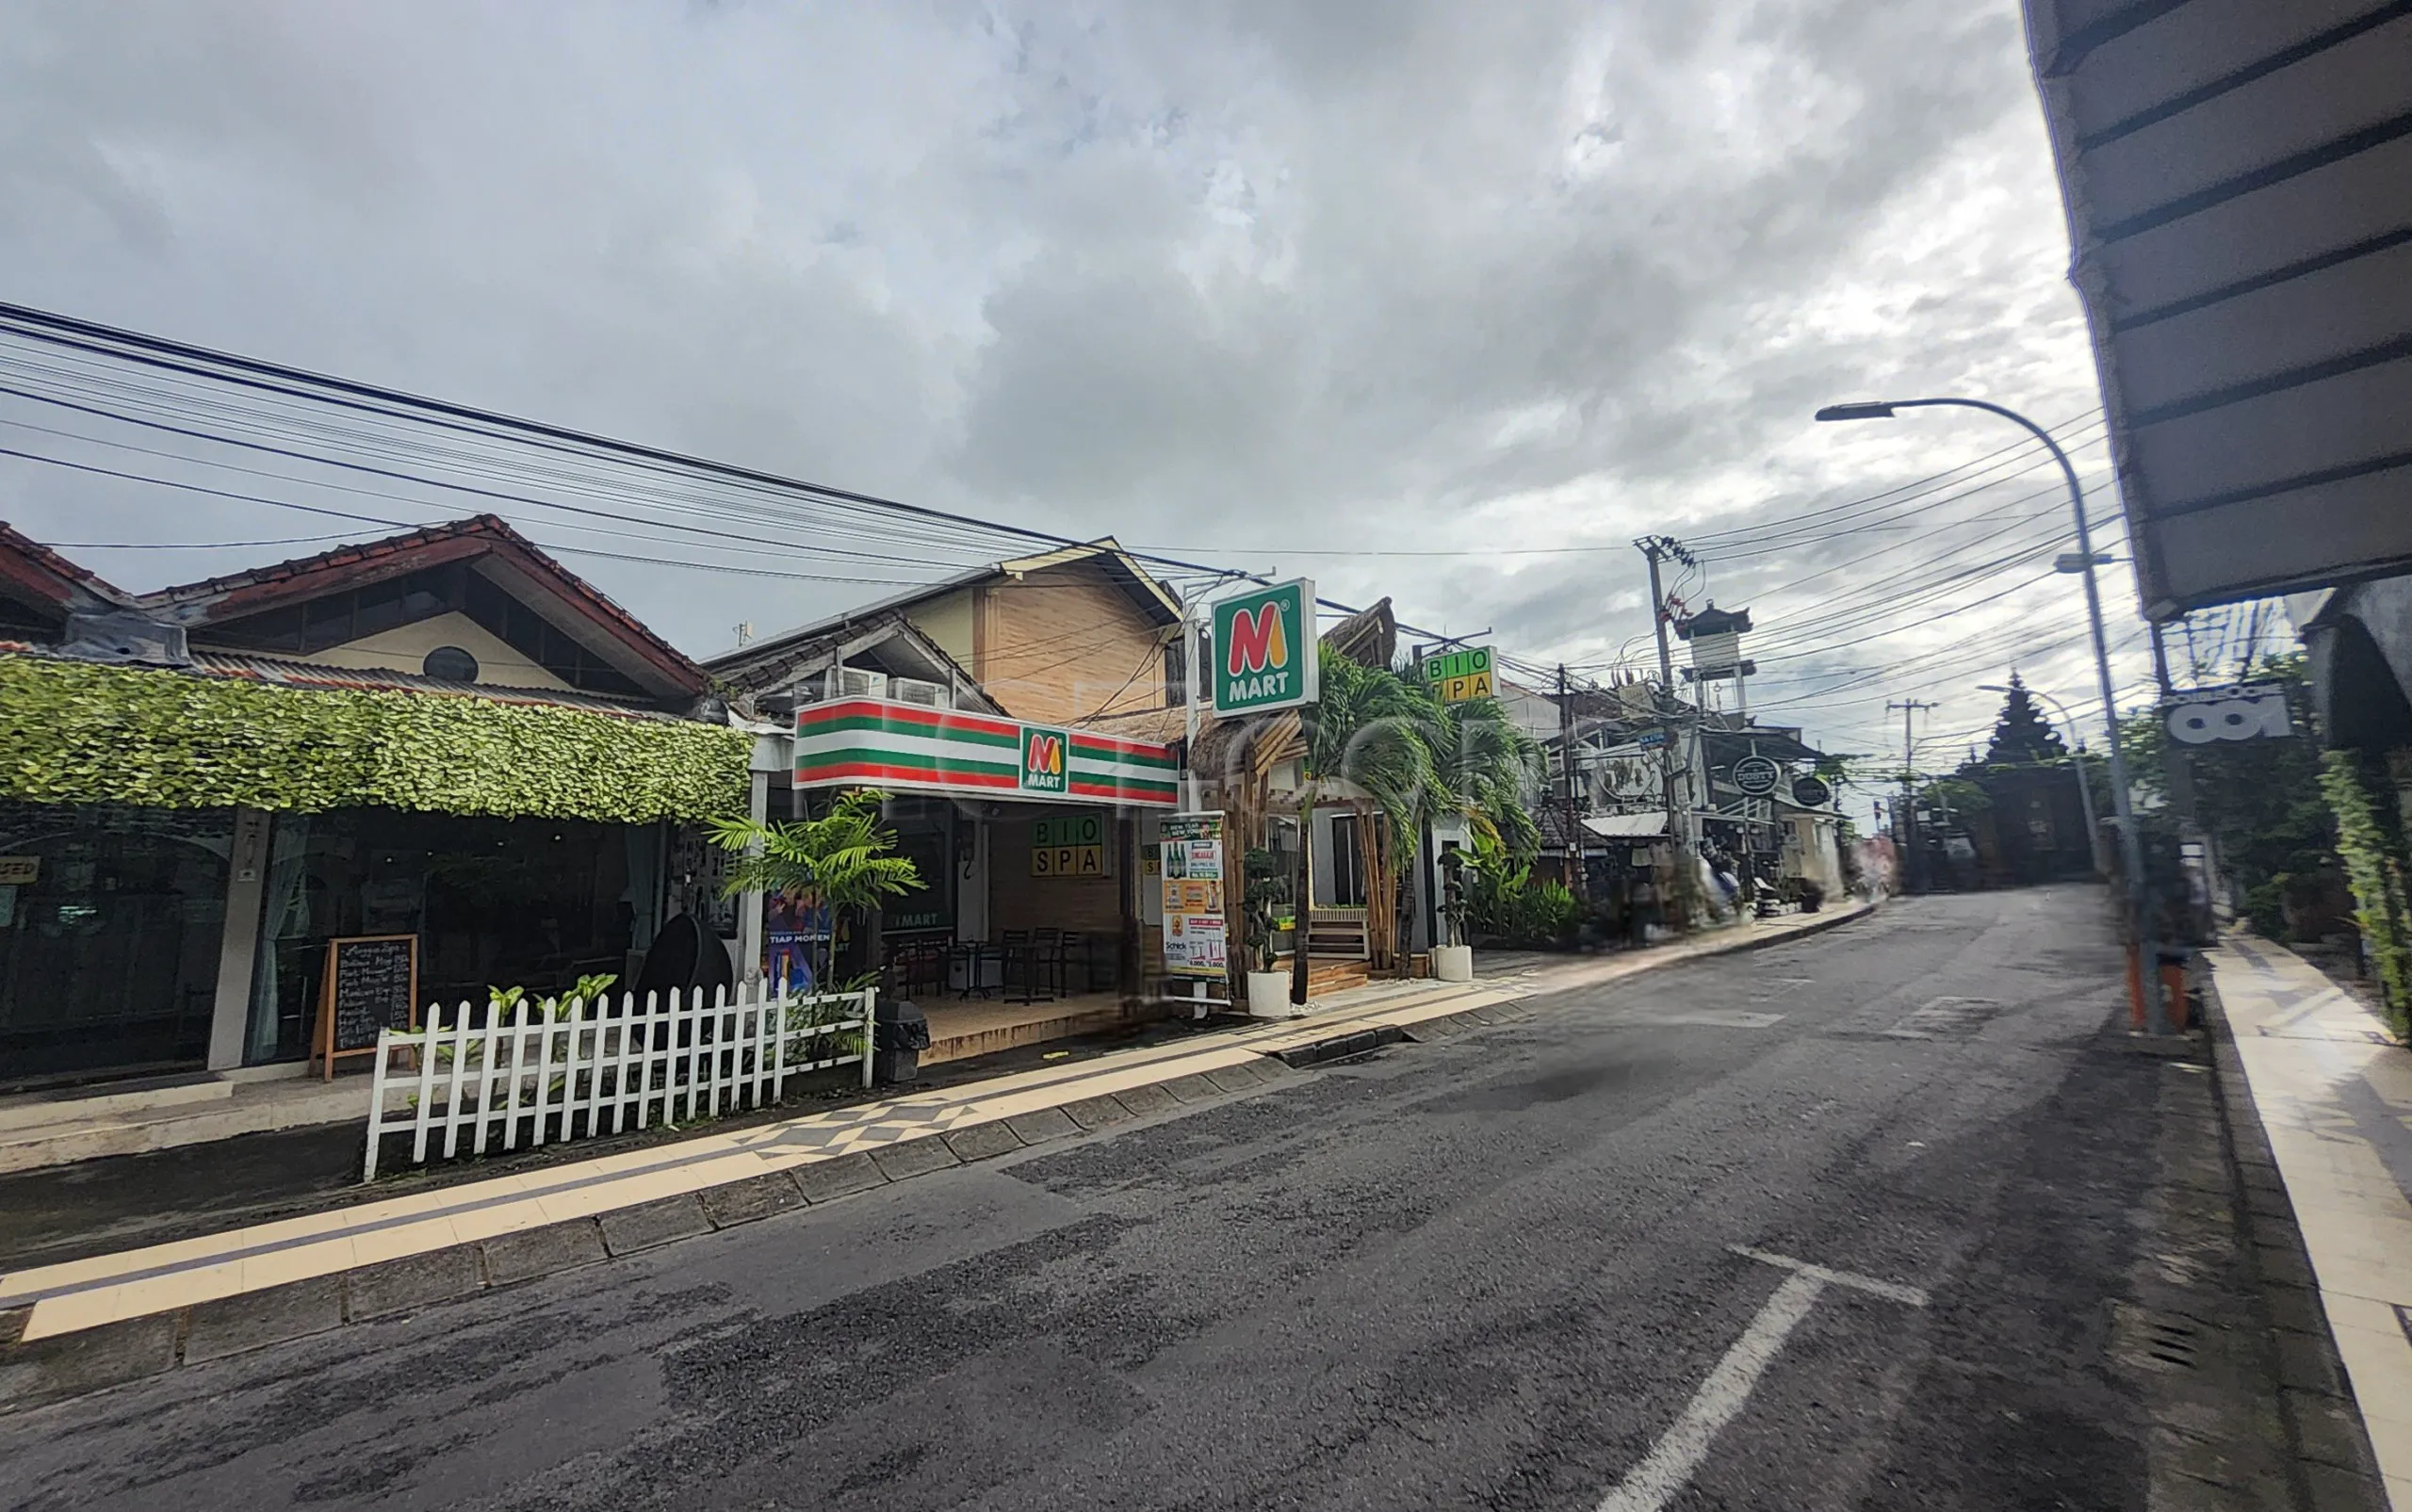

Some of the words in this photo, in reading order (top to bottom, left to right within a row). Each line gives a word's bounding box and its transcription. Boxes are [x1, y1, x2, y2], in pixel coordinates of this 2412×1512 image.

[1429, 651, 1487, 678] BIO
[1229, 672, 1289, 703] MART
[1027, 773, 1061, 789] MART
[1036, 819, 1097, 843] BIO
[1037, 849, 1097, 872] SPA
[902, 913, 938, 927] MART
[769, 935, 793, 944] TIAP
